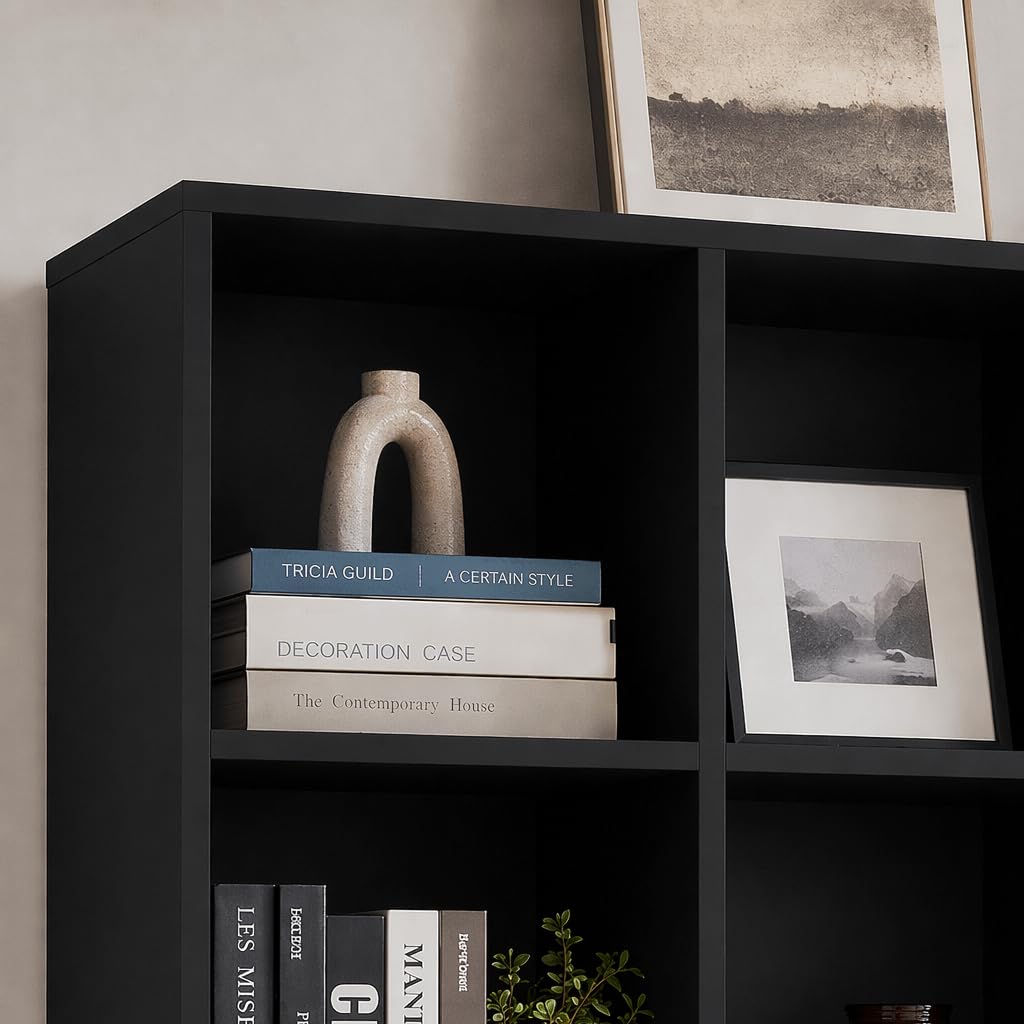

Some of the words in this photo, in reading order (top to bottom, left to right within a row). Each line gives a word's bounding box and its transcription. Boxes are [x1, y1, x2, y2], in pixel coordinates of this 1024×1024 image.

[281, 563, 338, 579] TRICIA
[342, 565, 394, 582] GUILD
[444, 570, 455, 583] A
[459, 571, 524, 585] CERTAIN
[528, 573, 574, 587] STYLE
[277, 641, 411, 661] DECORATION
[422, 645, 476, 663] CASE
[293, 693, 322, 709] The
[332, 694, 440, 715] Contemporary
[450, 698, 496, 713] House
[236, 907, 255, 953] LES
